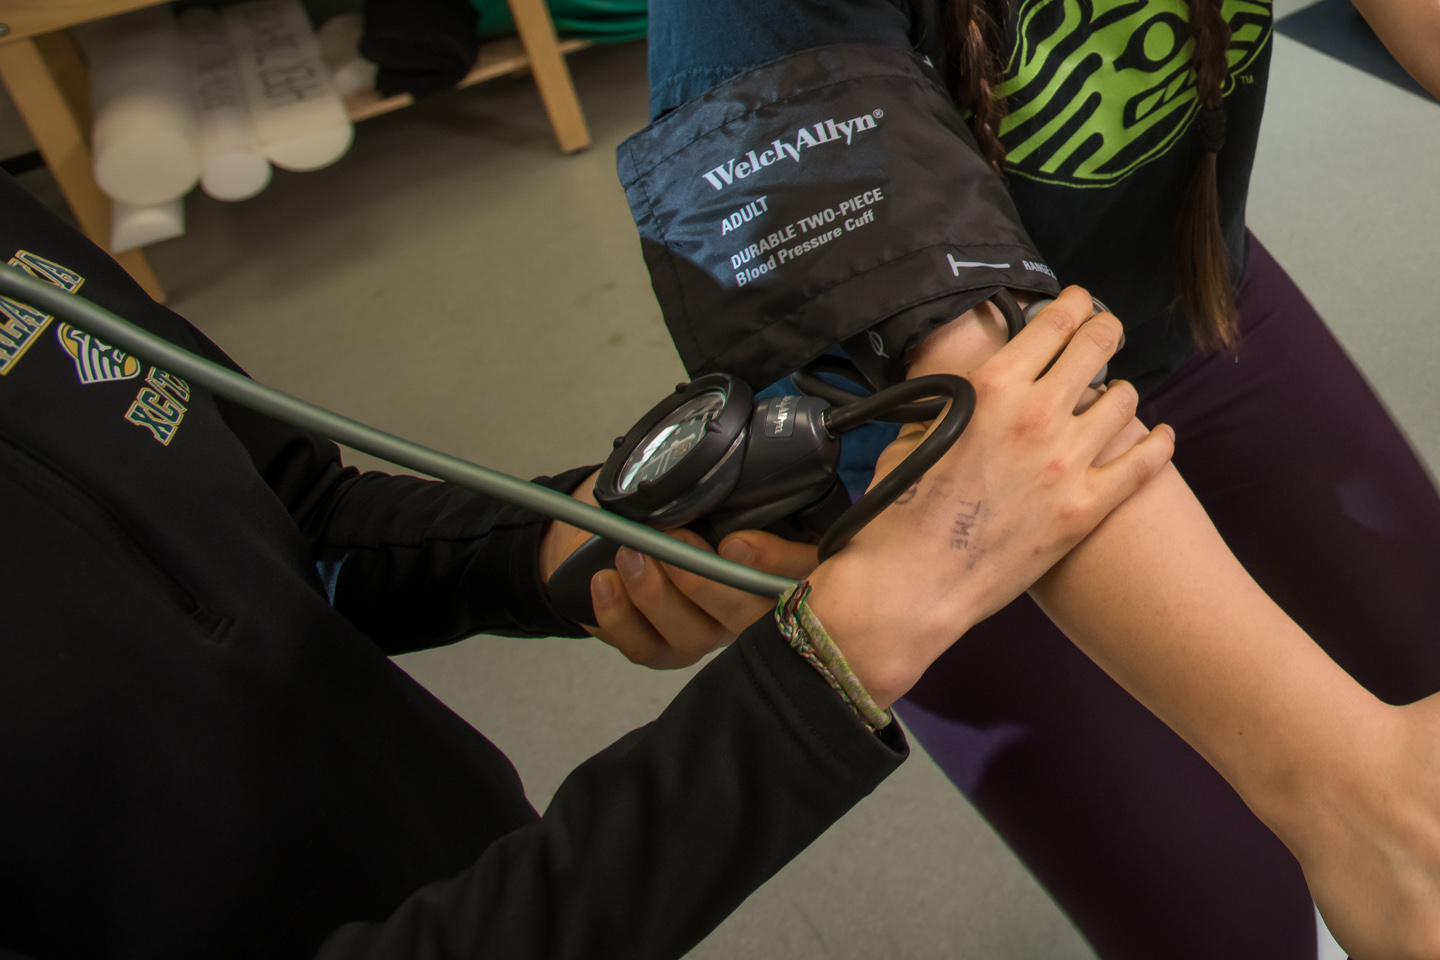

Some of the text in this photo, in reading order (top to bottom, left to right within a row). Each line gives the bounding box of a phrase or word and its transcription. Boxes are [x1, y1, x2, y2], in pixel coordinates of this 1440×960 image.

[721, 195, 769, 236] ADULT
[730, 187, 884, 270] DURABLE TWO-PIECE
[735, 208, 875, 288] Blood Pressure Cuff
